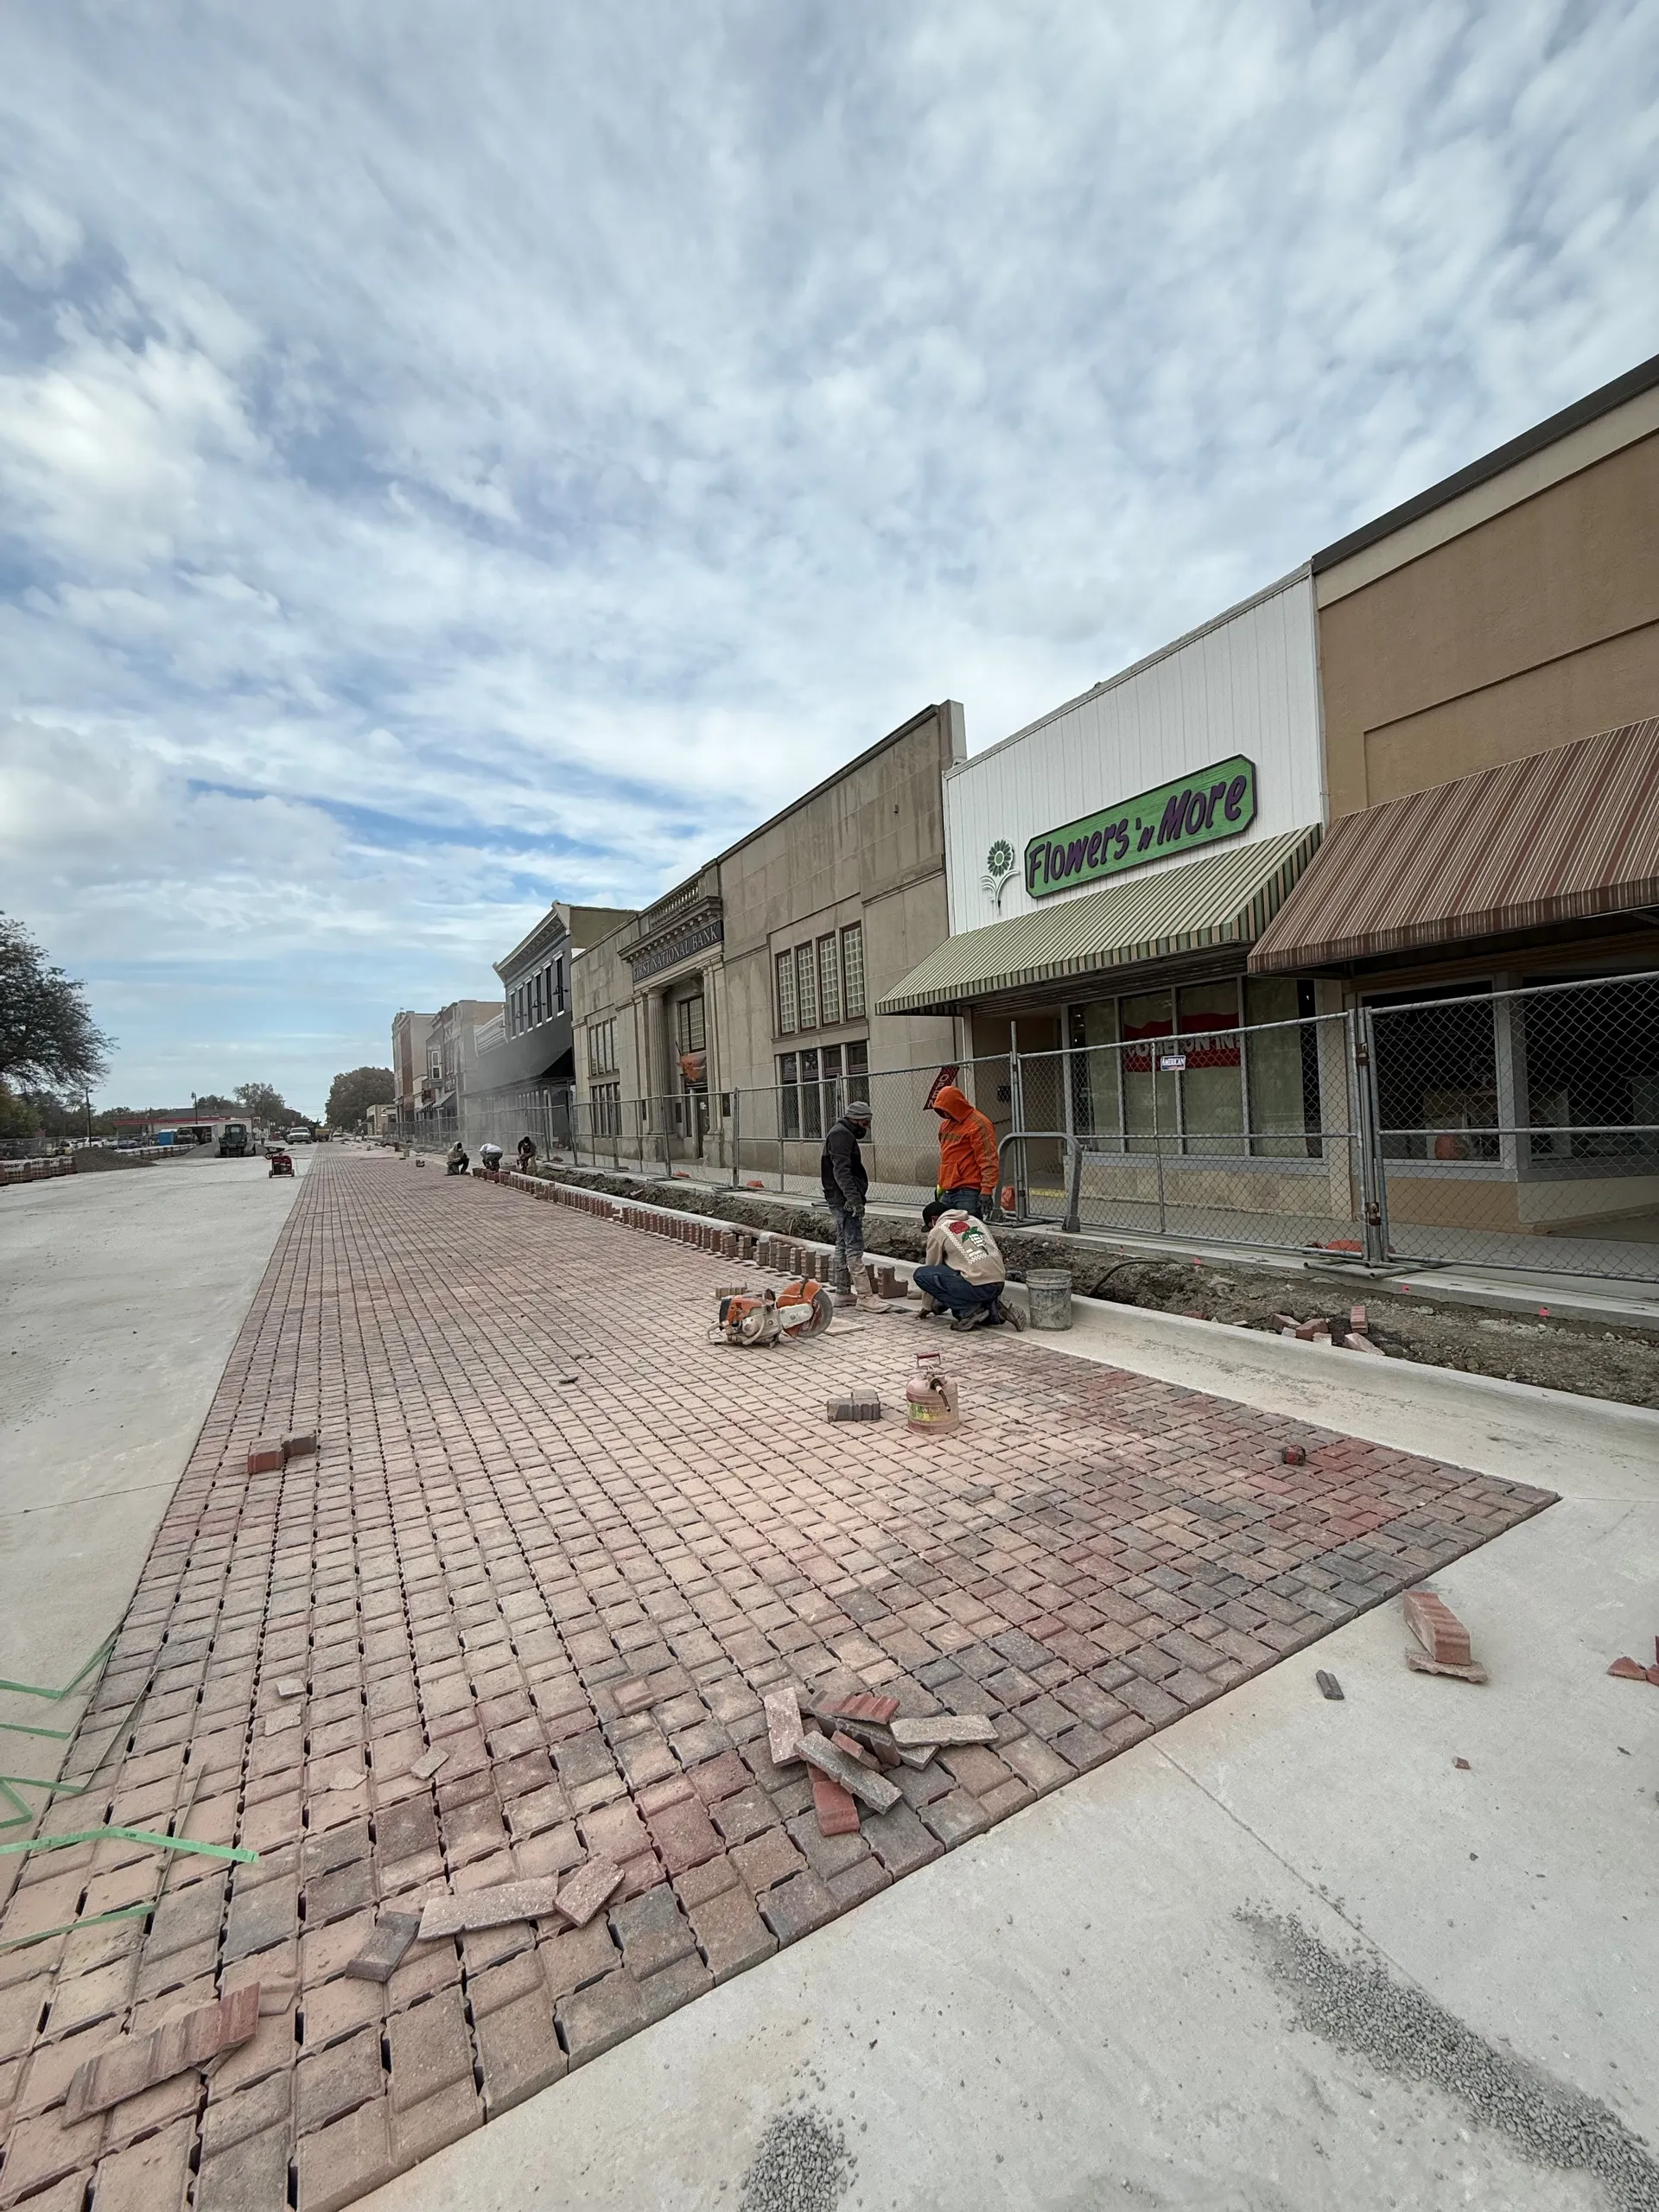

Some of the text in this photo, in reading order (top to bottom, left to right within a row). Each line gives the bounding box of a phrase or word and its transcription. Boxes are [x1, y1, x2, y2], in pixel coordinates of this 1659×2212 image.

[1029, 818, 1129, 888] Flowers
[1157, 774, 1247, 845] More
[633, 924, 718, 981] FIRST NATIONAL BANK
[1161, 1057, 1185, 1066] AMERICAN
